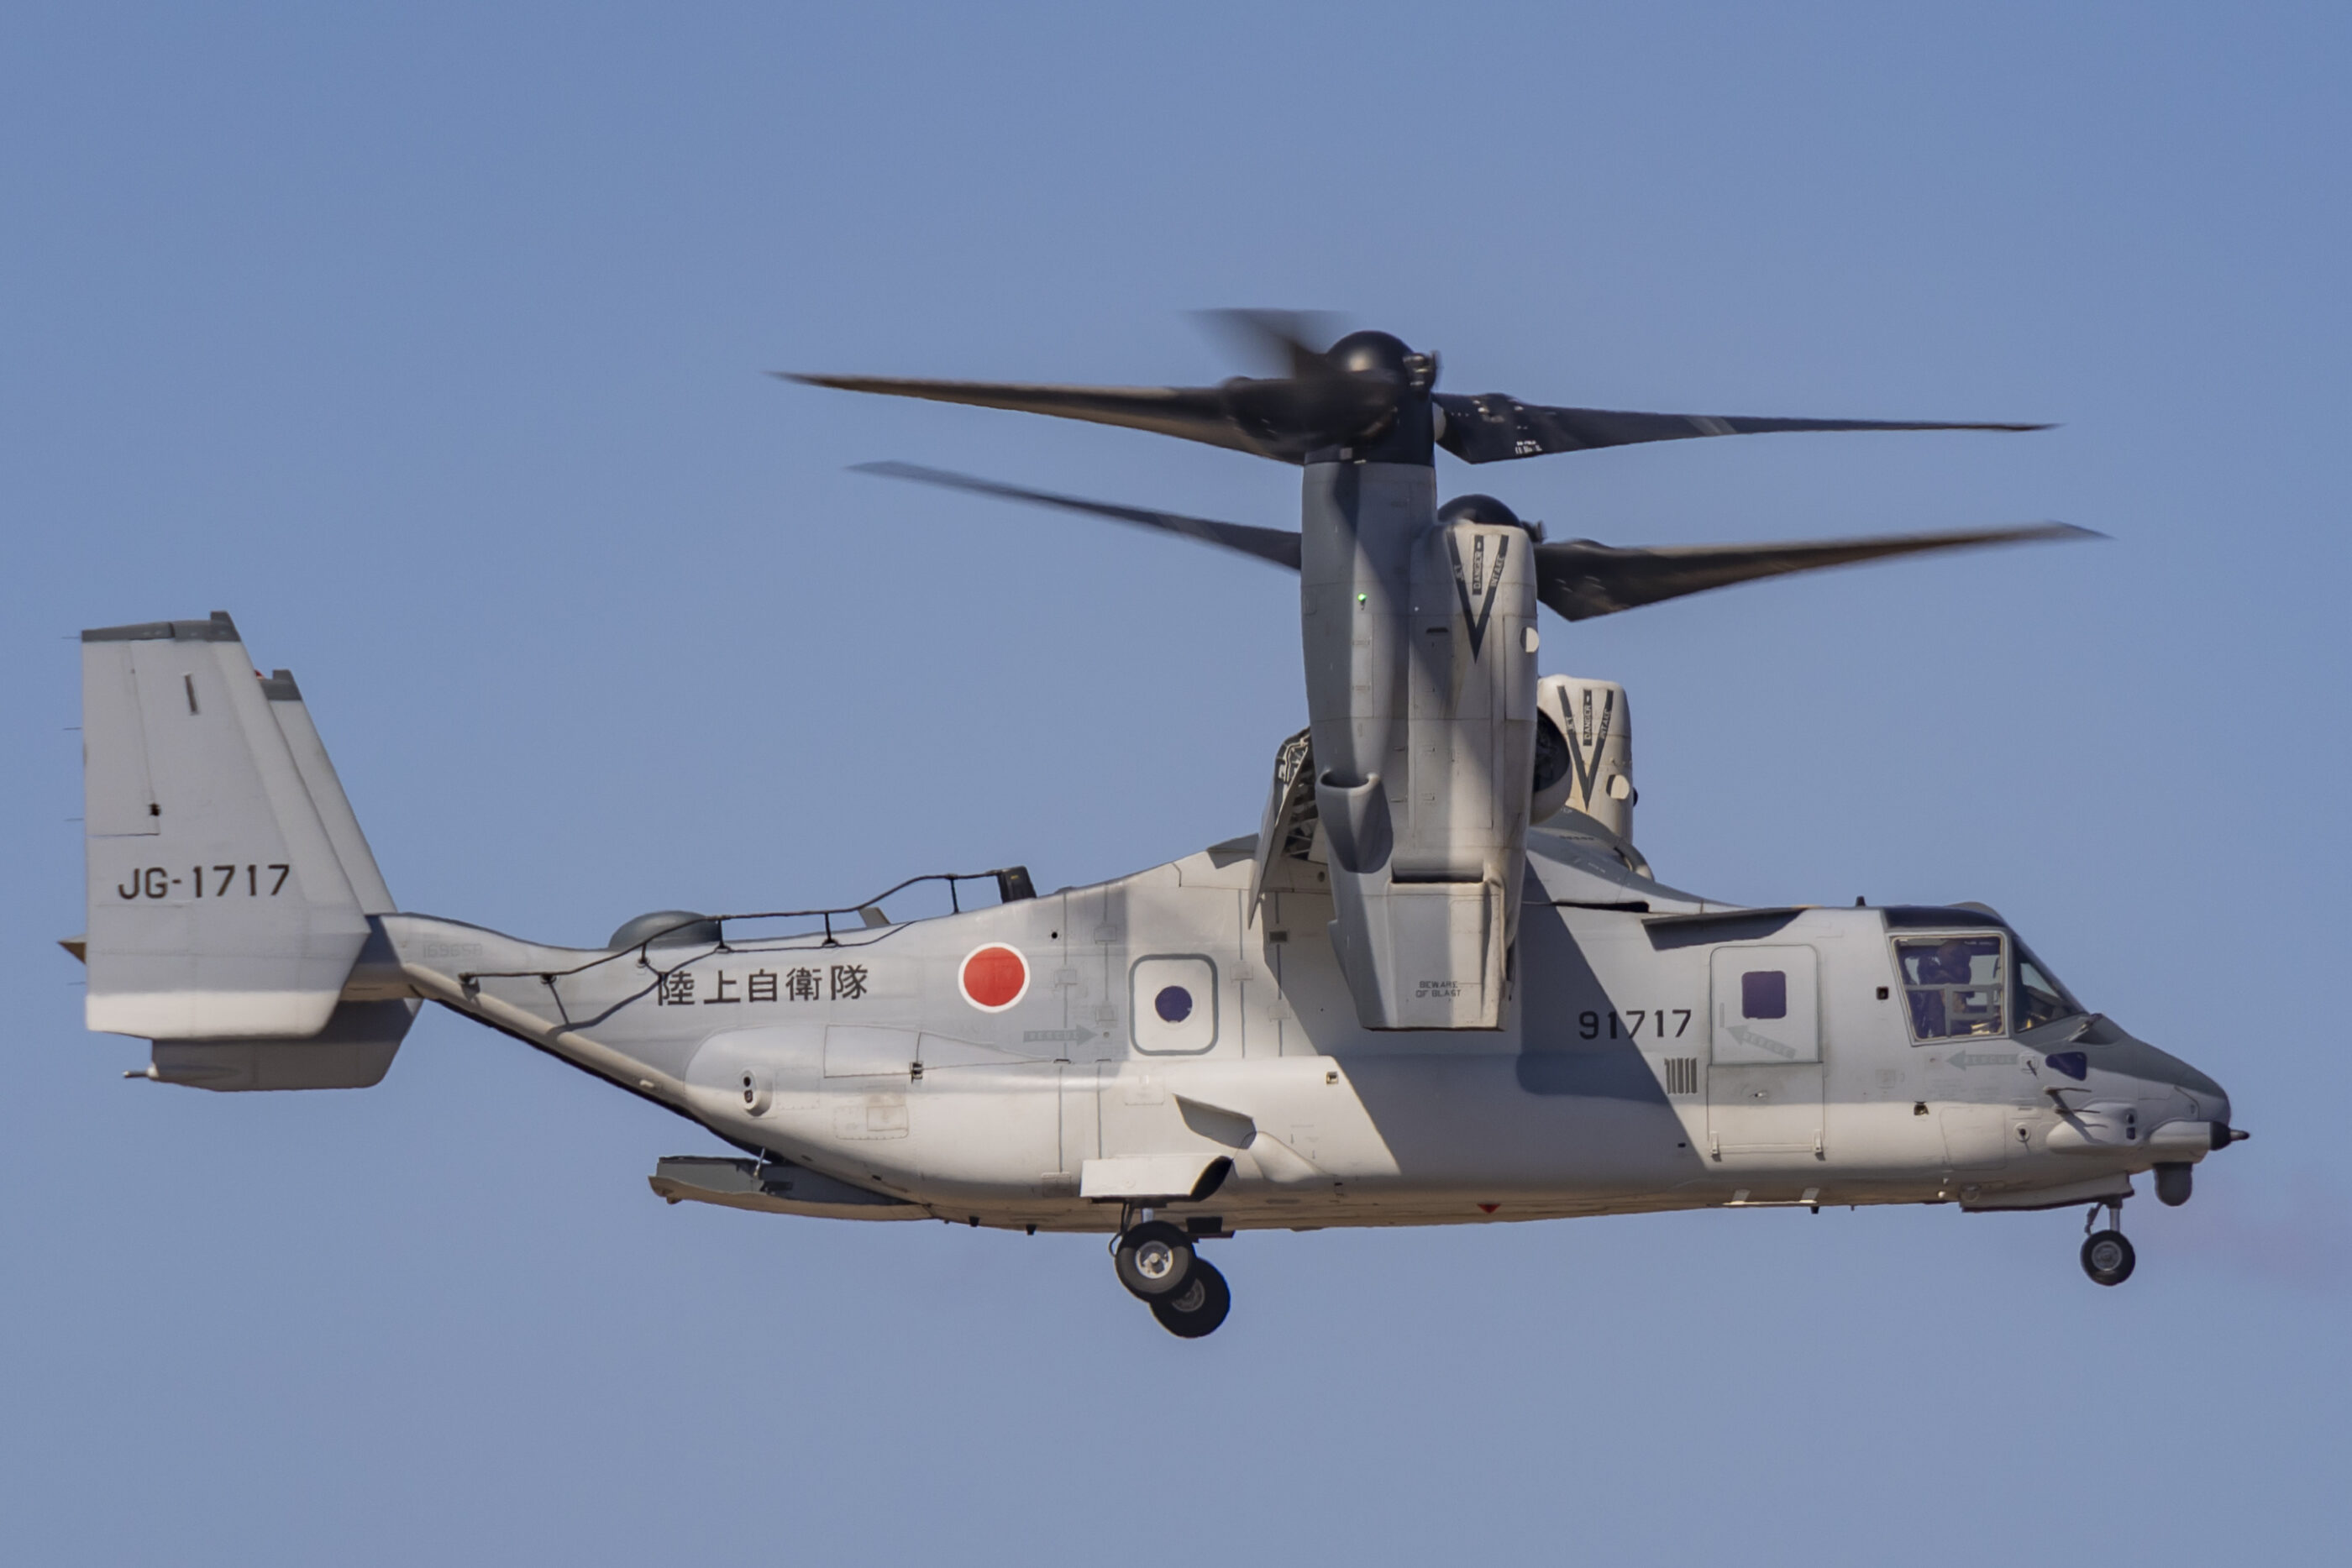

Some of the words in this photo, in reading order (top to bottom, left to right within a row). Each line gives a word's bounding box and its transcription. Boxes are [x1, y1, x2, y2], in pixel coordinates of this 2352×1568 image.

[1473, 551, 1483, 590] DANGER
[1490, 556, 1505, 587] INTAKE
[1583, 705, 1592, 740] DANGER
[118, 864, 290, 899] JG-1717
[658, 964, 868, 1006] 陸上自衛隊
[1415, 989, 1428, 998] OF
[1431, 989, 1462, 998] BLAST
[1579, 1009, 1691, 1040] 91717
